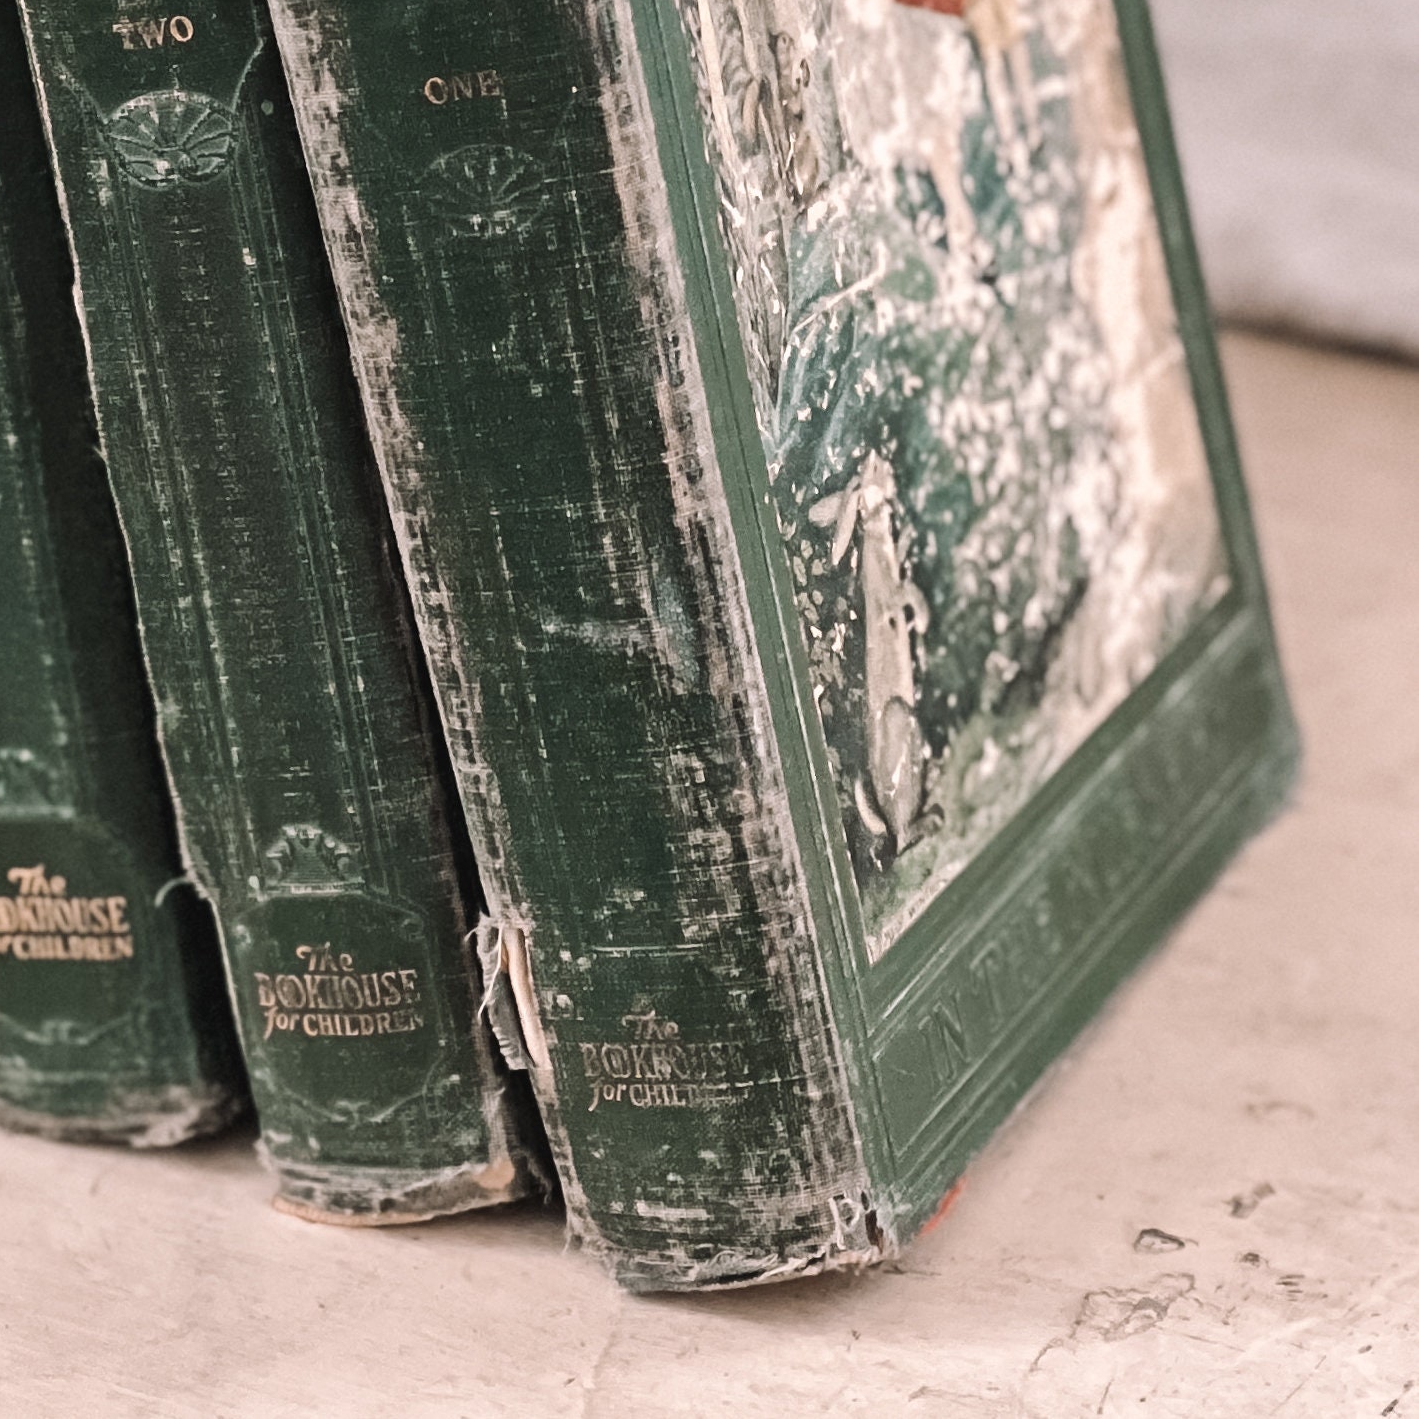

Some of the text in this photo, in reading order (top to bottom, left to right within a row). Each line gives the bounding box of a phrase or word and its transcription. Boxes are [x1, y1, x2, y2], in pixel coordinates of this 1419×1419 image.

[113, 15, 194, 50] TWO
[7, 863, 67, 895] The
[295, 941, 354, 972] The
[254, 968, 420, 1010] BOOKHOUSE
[263, 1006, 424, 1040] for CHILDREN
[621, 1009, 681, 1040] The
[588, 1077, 749, 1112] for CHILD
